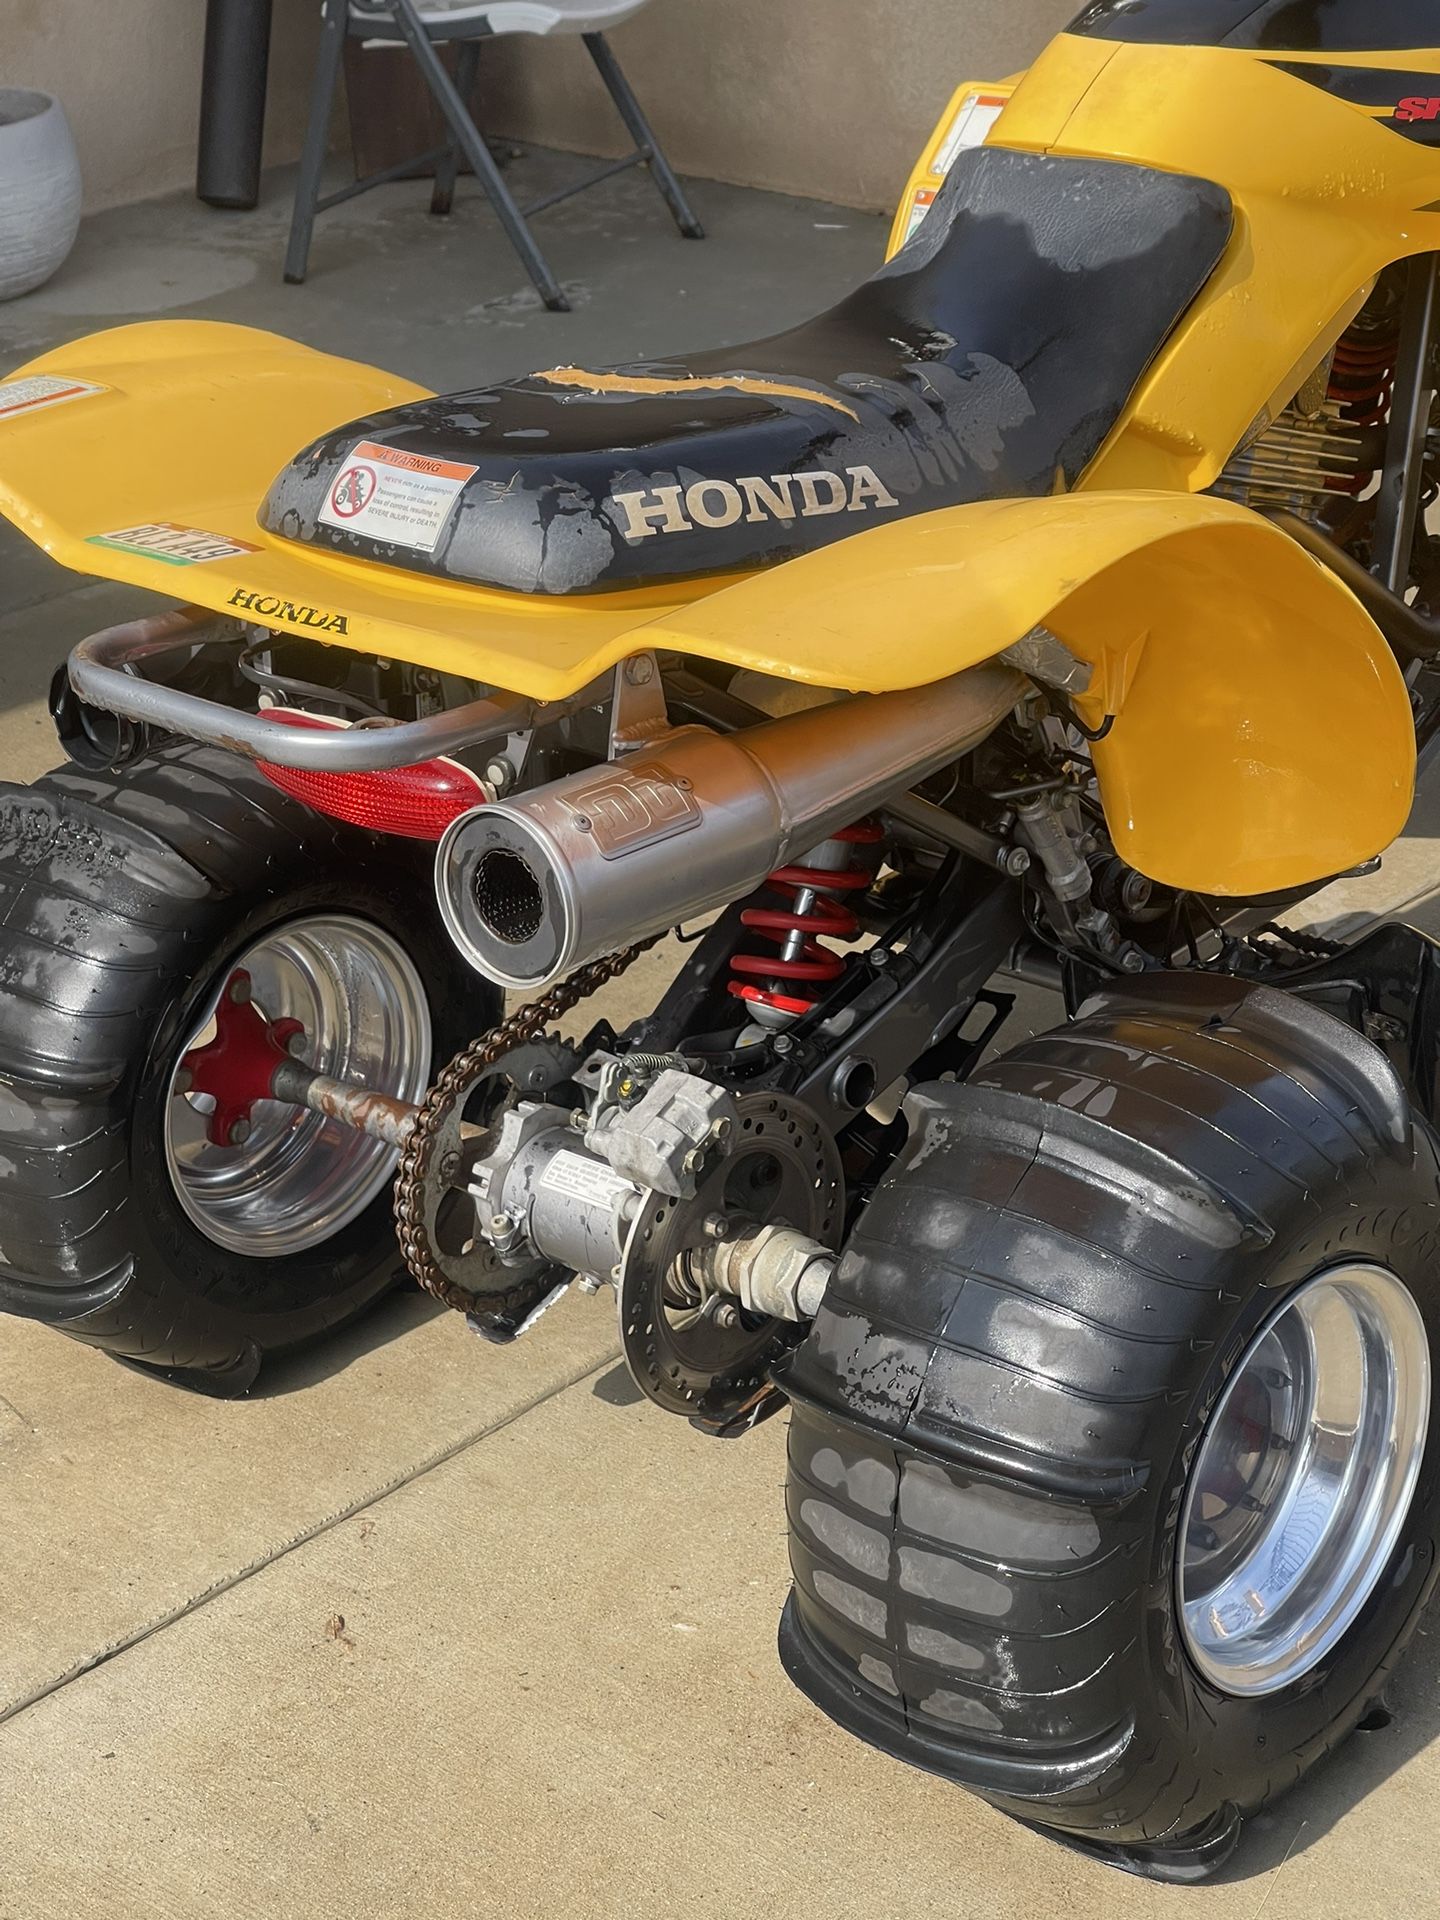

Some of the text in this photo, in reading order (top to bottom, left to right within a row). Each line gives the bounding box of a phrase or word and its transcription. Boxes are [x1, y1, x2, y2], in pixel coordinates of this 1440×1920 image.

[391, 454, 442, 472] WARNING
[613, 465, 899, 539] HONDA
[227, 587, 349, 635] HONDA
